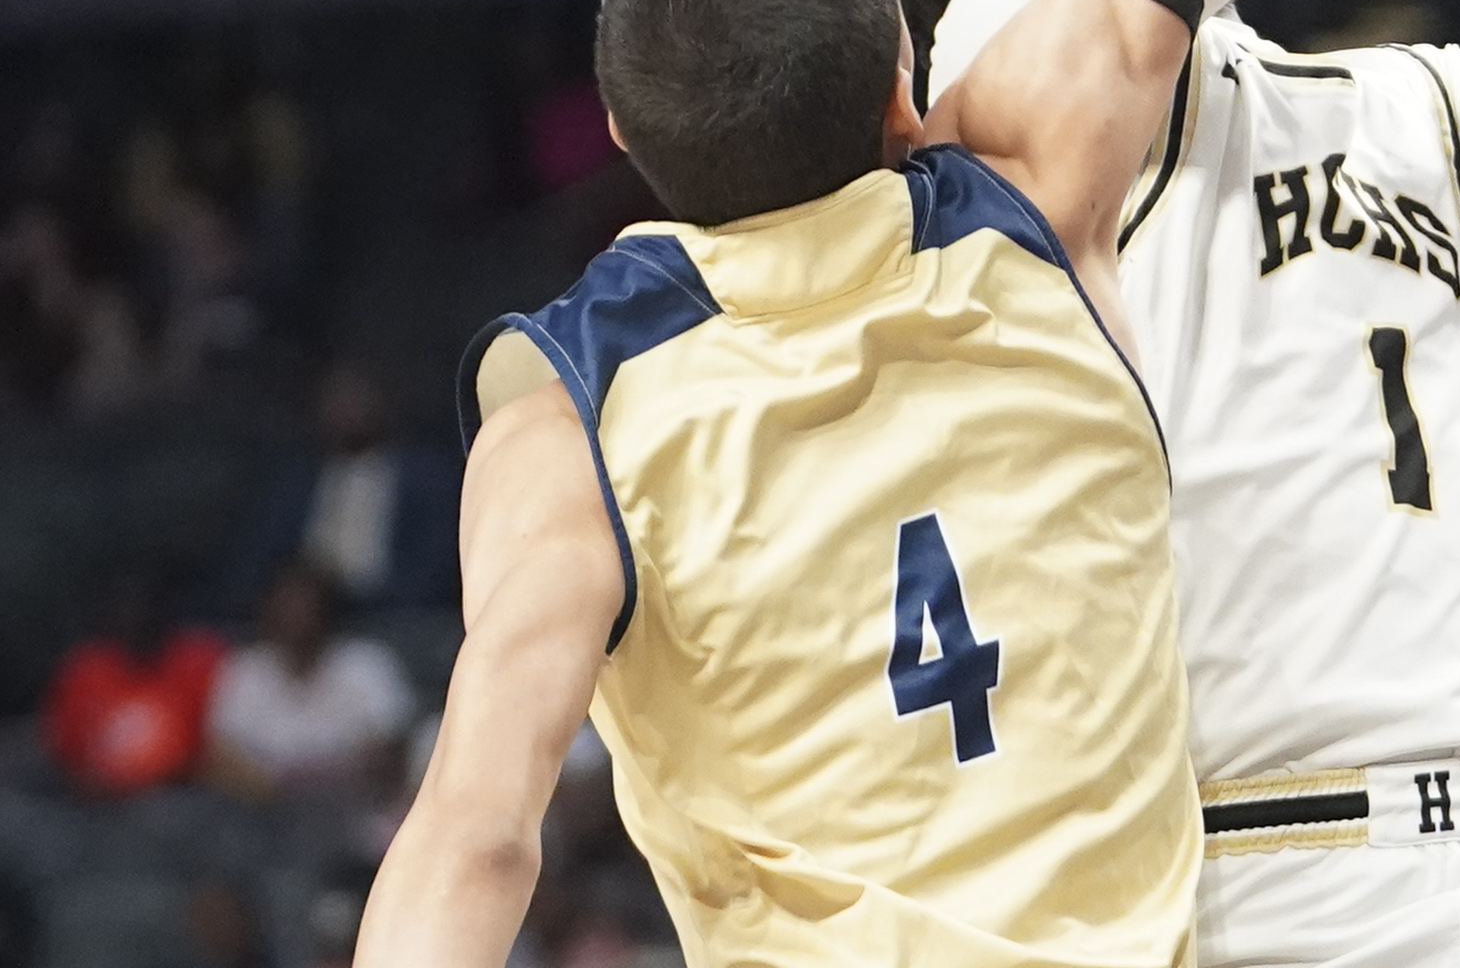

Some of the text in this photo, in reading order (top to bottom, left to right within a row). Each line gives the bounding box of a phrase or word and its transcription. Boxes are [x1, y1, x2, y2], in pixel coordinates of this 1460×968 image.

[1365, 324, 1436, 514] 1
[886, 510, 1001, 766] 4
[1414, 770, 1455, 834] H
